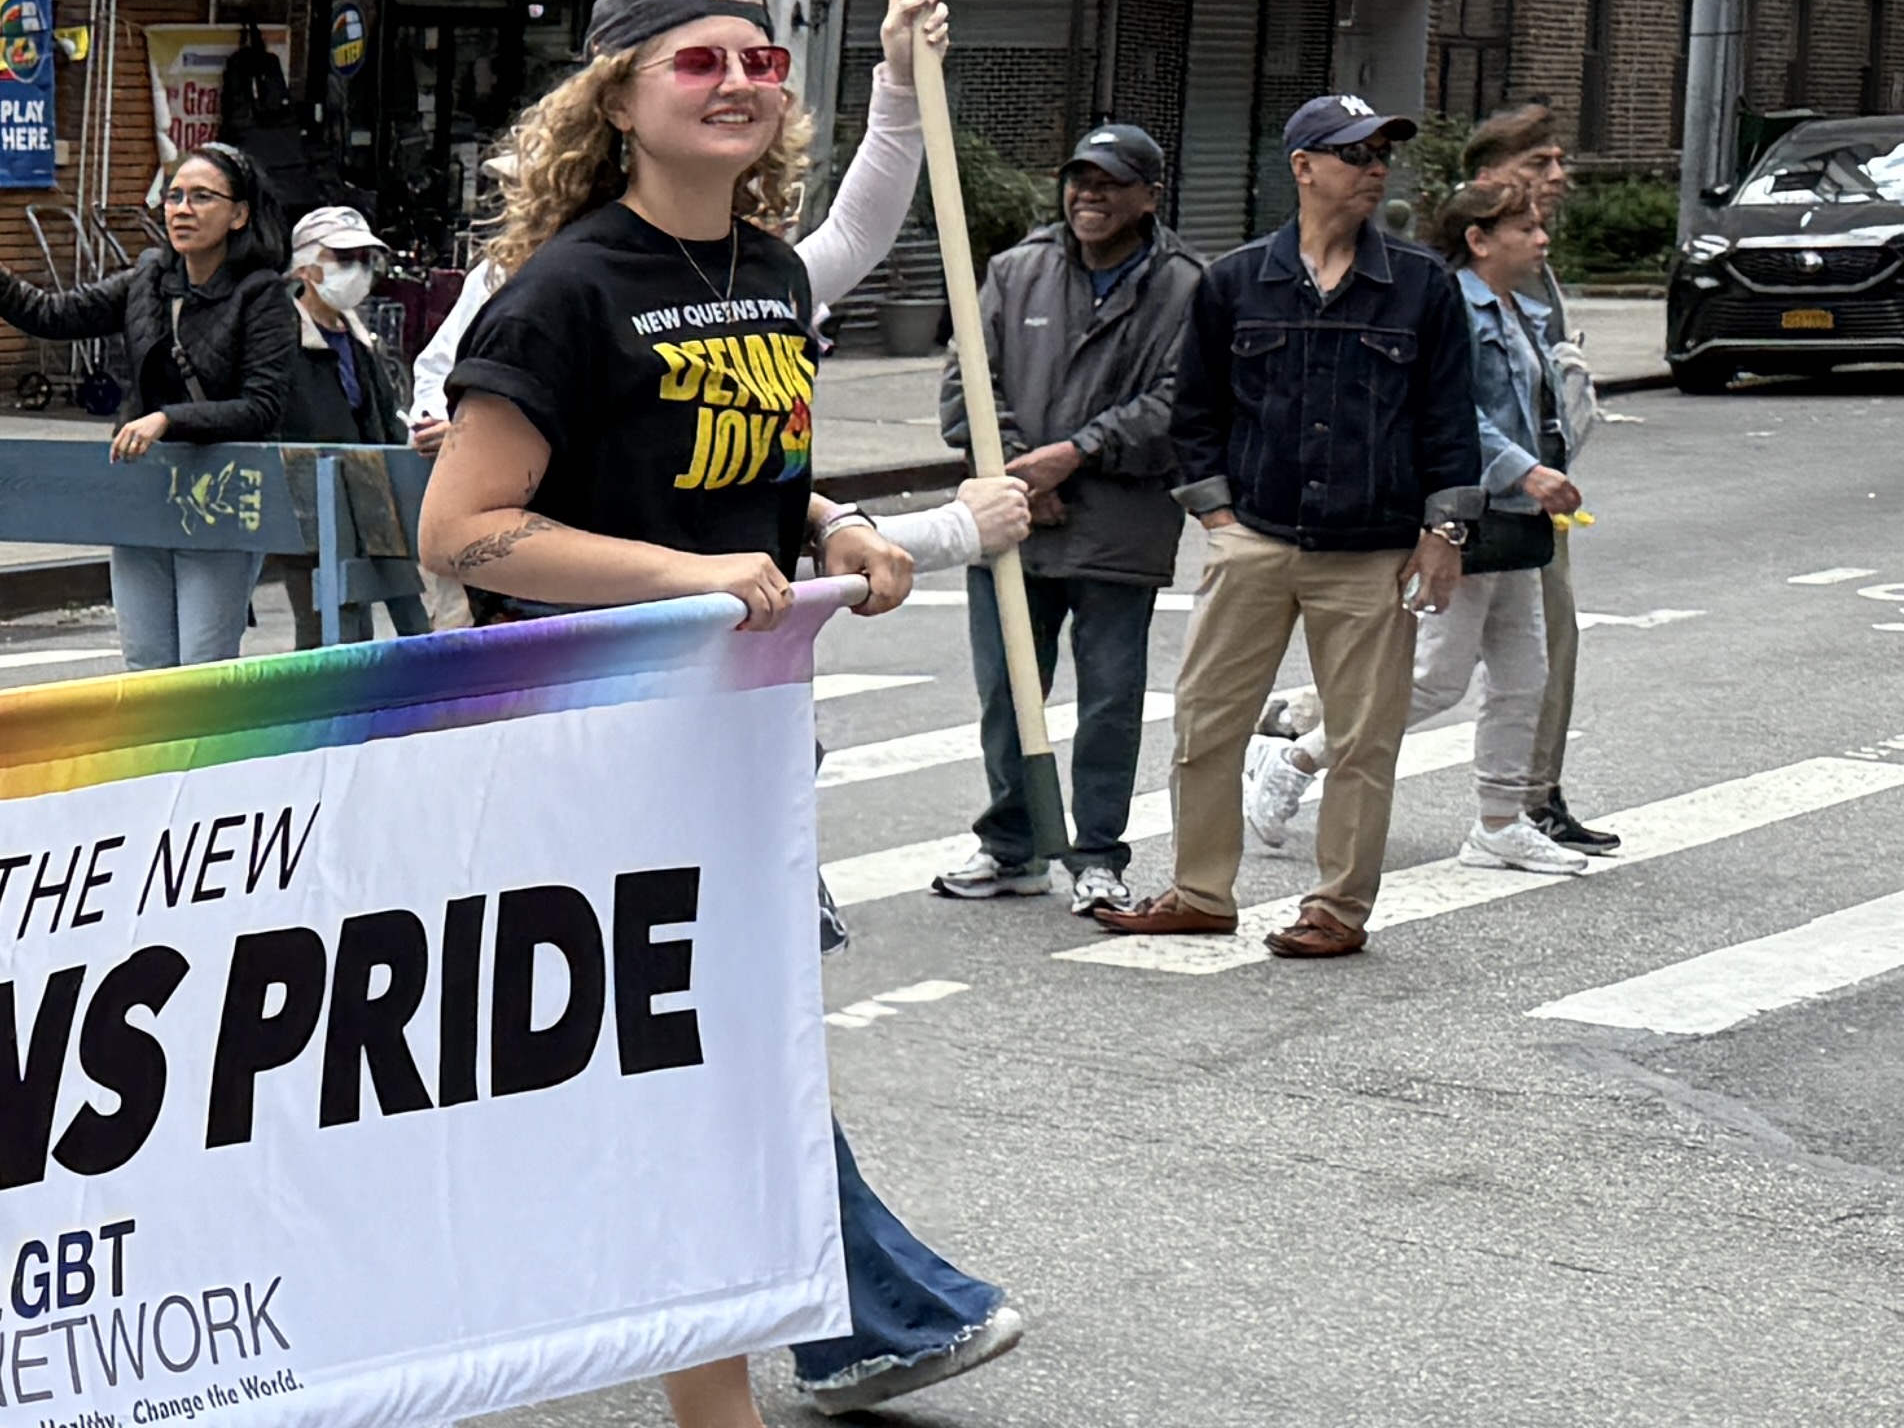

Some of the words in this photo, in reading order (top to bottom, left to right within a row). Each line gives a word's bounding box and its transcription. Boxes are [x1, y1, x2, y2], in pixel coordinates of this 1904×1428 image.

[0, 100, 45, 123] PLAY
[1, 127, 52, 151] HERE.
[631, 309, 683, 336] NEW
[683, 299, 758, 331] QUEENS
[652, 333, 816, 413] DEFIANT
[673, 406, 779, 490] JOY
[137, 801, 322, 920] NEW
[205, 865, 705, 1150] PRIDE
[132, 1396, 205, 1427] Change
[206, 1382, 239, 1409] the
[239, 1368, 304, 1400] World.
